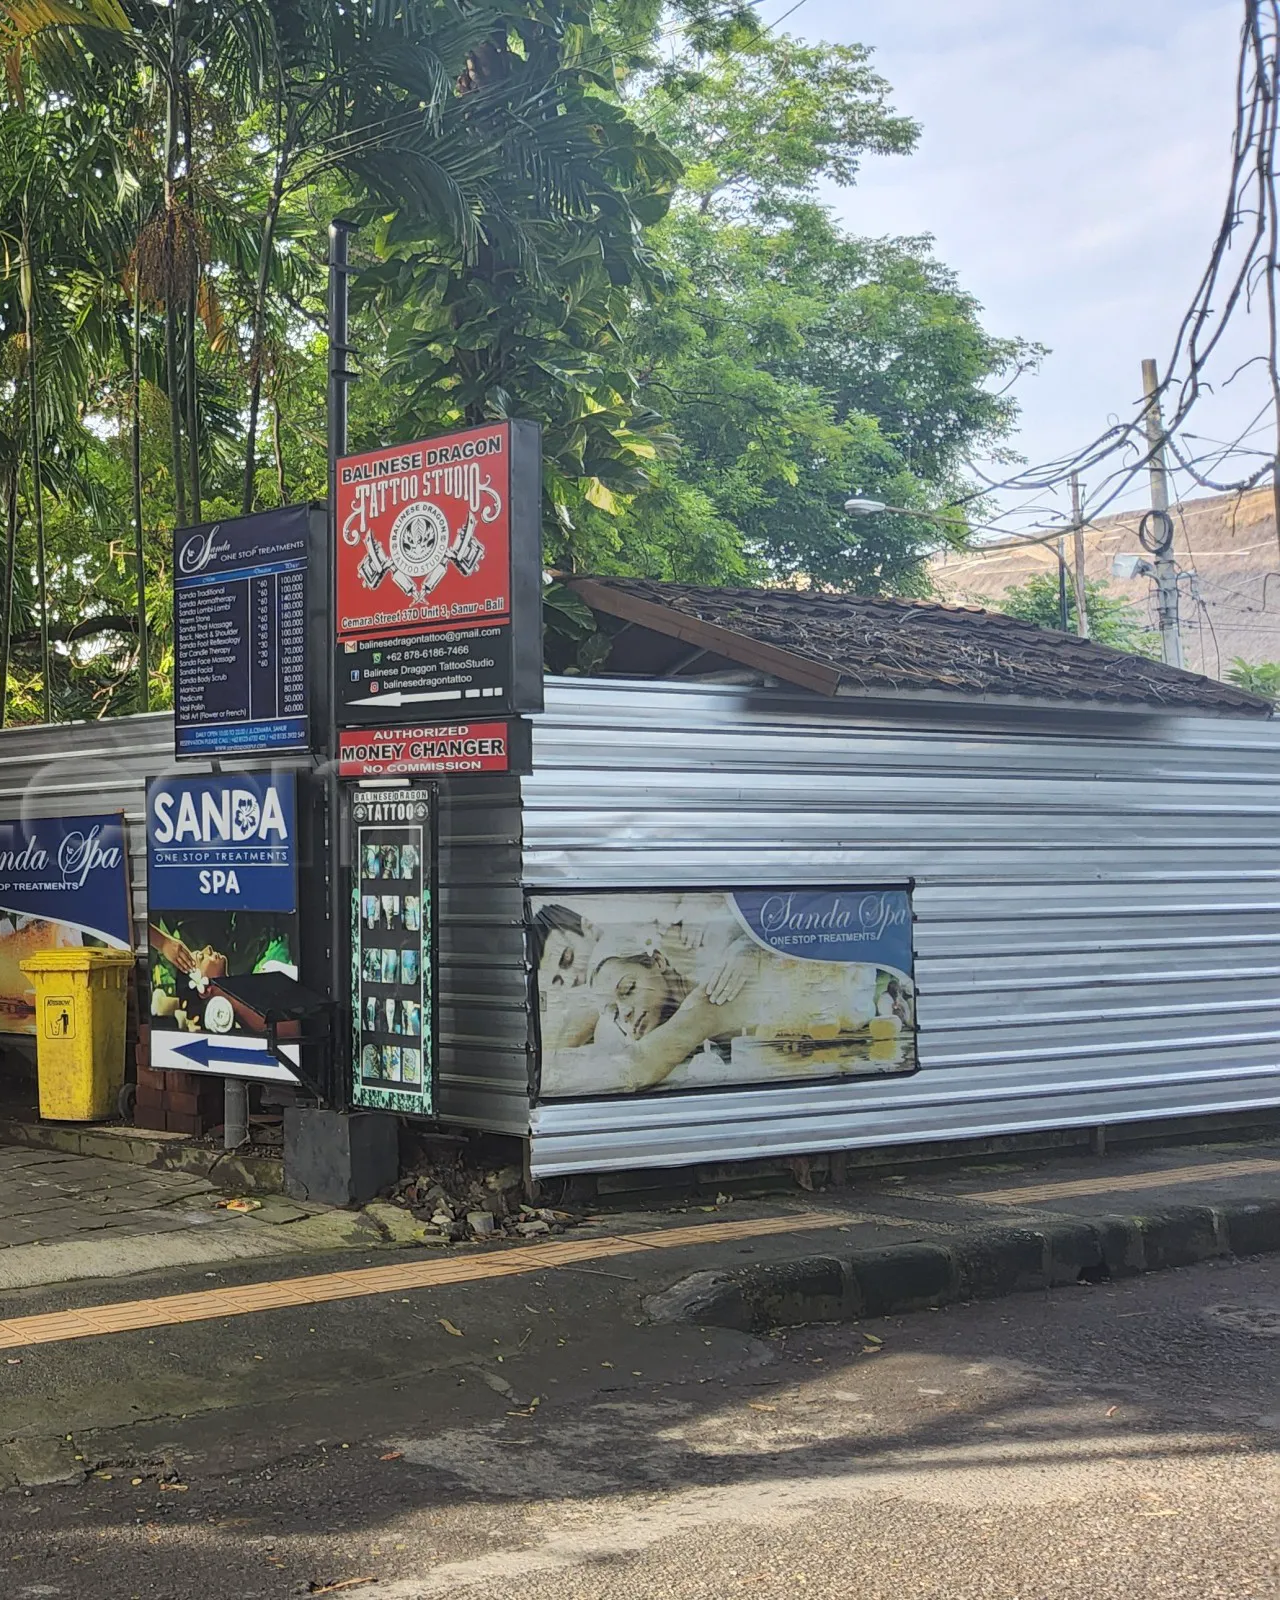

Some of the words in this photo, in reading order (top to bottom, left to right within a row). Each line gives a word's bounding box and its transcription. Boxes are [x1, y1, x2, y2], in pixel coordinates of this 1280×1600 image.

[341, 451, 423, 485] BALINESE
[426, 434, 502, 467] DRAGON
[352, 474, 418, 533] TATTOO
[422, 462, 482, 513] STUDIO
[391, 504, 421, 541] BALINESE
[422, 504, 447, 533] DRAGON
[220, 551, 237, 562] ONE
[238, 548, 256, 559] STOP
[258, 540, 305, 554] TREATMENTS
[179, 592, 196, 600] Sanda
[197, 587, 225, 597] Traditional
[281, 574, 304, 584] 100.000
[179, 601, 196, 609] Sanda
[197, 595, 236, 606] Aromatherapy
[281, 583, 304, 593] 100.000
[179, 609, 196, 617] Sanda
[341, 615, 373, 630] Cemara
[373, 611, 401, 625] Street
[401, 609, 419, 621] 37D
[420, 606, 439, 618] Unit
[451, 601, 478, 615] Sanur
[484, 597, 505, 611] Bali
[208, 621, 233, 629] Massage
[214, 628, 239, 637] Shoulder
[281, 618, 304, 628] 100.000
[179, 642, 196, 650] Sanda
[281, 627, 304, 637] 100.000
[209, 647, 231, 655] Therapy
[281, 636, 304, 646] 100.000
[359, 627, 501, 650] balinesedragontattoo@gmail.com
[284, 645, 304, 655] 70.000
[386, 652, 402, 662] +62
[403, 645, 469, 660] 878-6186-7466
[281, 655, 304, 665] 100.000
[363, 668, 399, 679] Balinese
[400, 663, 437, 676] Draggon
[439, 657, 495, 671] TattooStudio
[179, 677, 196, 685] Sanda
[281, 664, 304, 674] 120.000
[284, 674, 304, 683] 80.000
[383, 674, 473, 690] balinesedragontattoo
[284, 683, 304, 692] 80.000
[284, 693, 304, 703] 50.000
[180, 713, 190, 721] Nail
[225, 708, 247, 718] French)
[284, 703, 304, 713] 60.000
[373, 725, 469, 741] AUTHORIZED
[341, 742, 407, 763] MONEY
[409, 738, 505, 759] CHANGER
[362, 764, 384, 774] NO
[386, 760, 482, 773] COMMISSION
[353, 791, 393, 803] BALINESE
[394, 790, 429, 801] DRAGON
[154, 786, 288, 843] SANDA
[366, 803, 415, 821] TATTOO
[58, 824, 123, 887] Spa
[155, 853, 178, 862] ONE
[182, 852, 210, 861] STOP
[215, 851, 288, 861] TREATMENTS
[13, 882, 80, 891] TREATMENTS
[198, 870, 240, 894] SPA
[760, 892, 851, 940] Sanda
[858, 892, 907, 940] Spa
[770, 936, 790, 946] ONE
[791, 935, 817, 944] STOP
[819, 932, 877, 943] TREATMENTS
